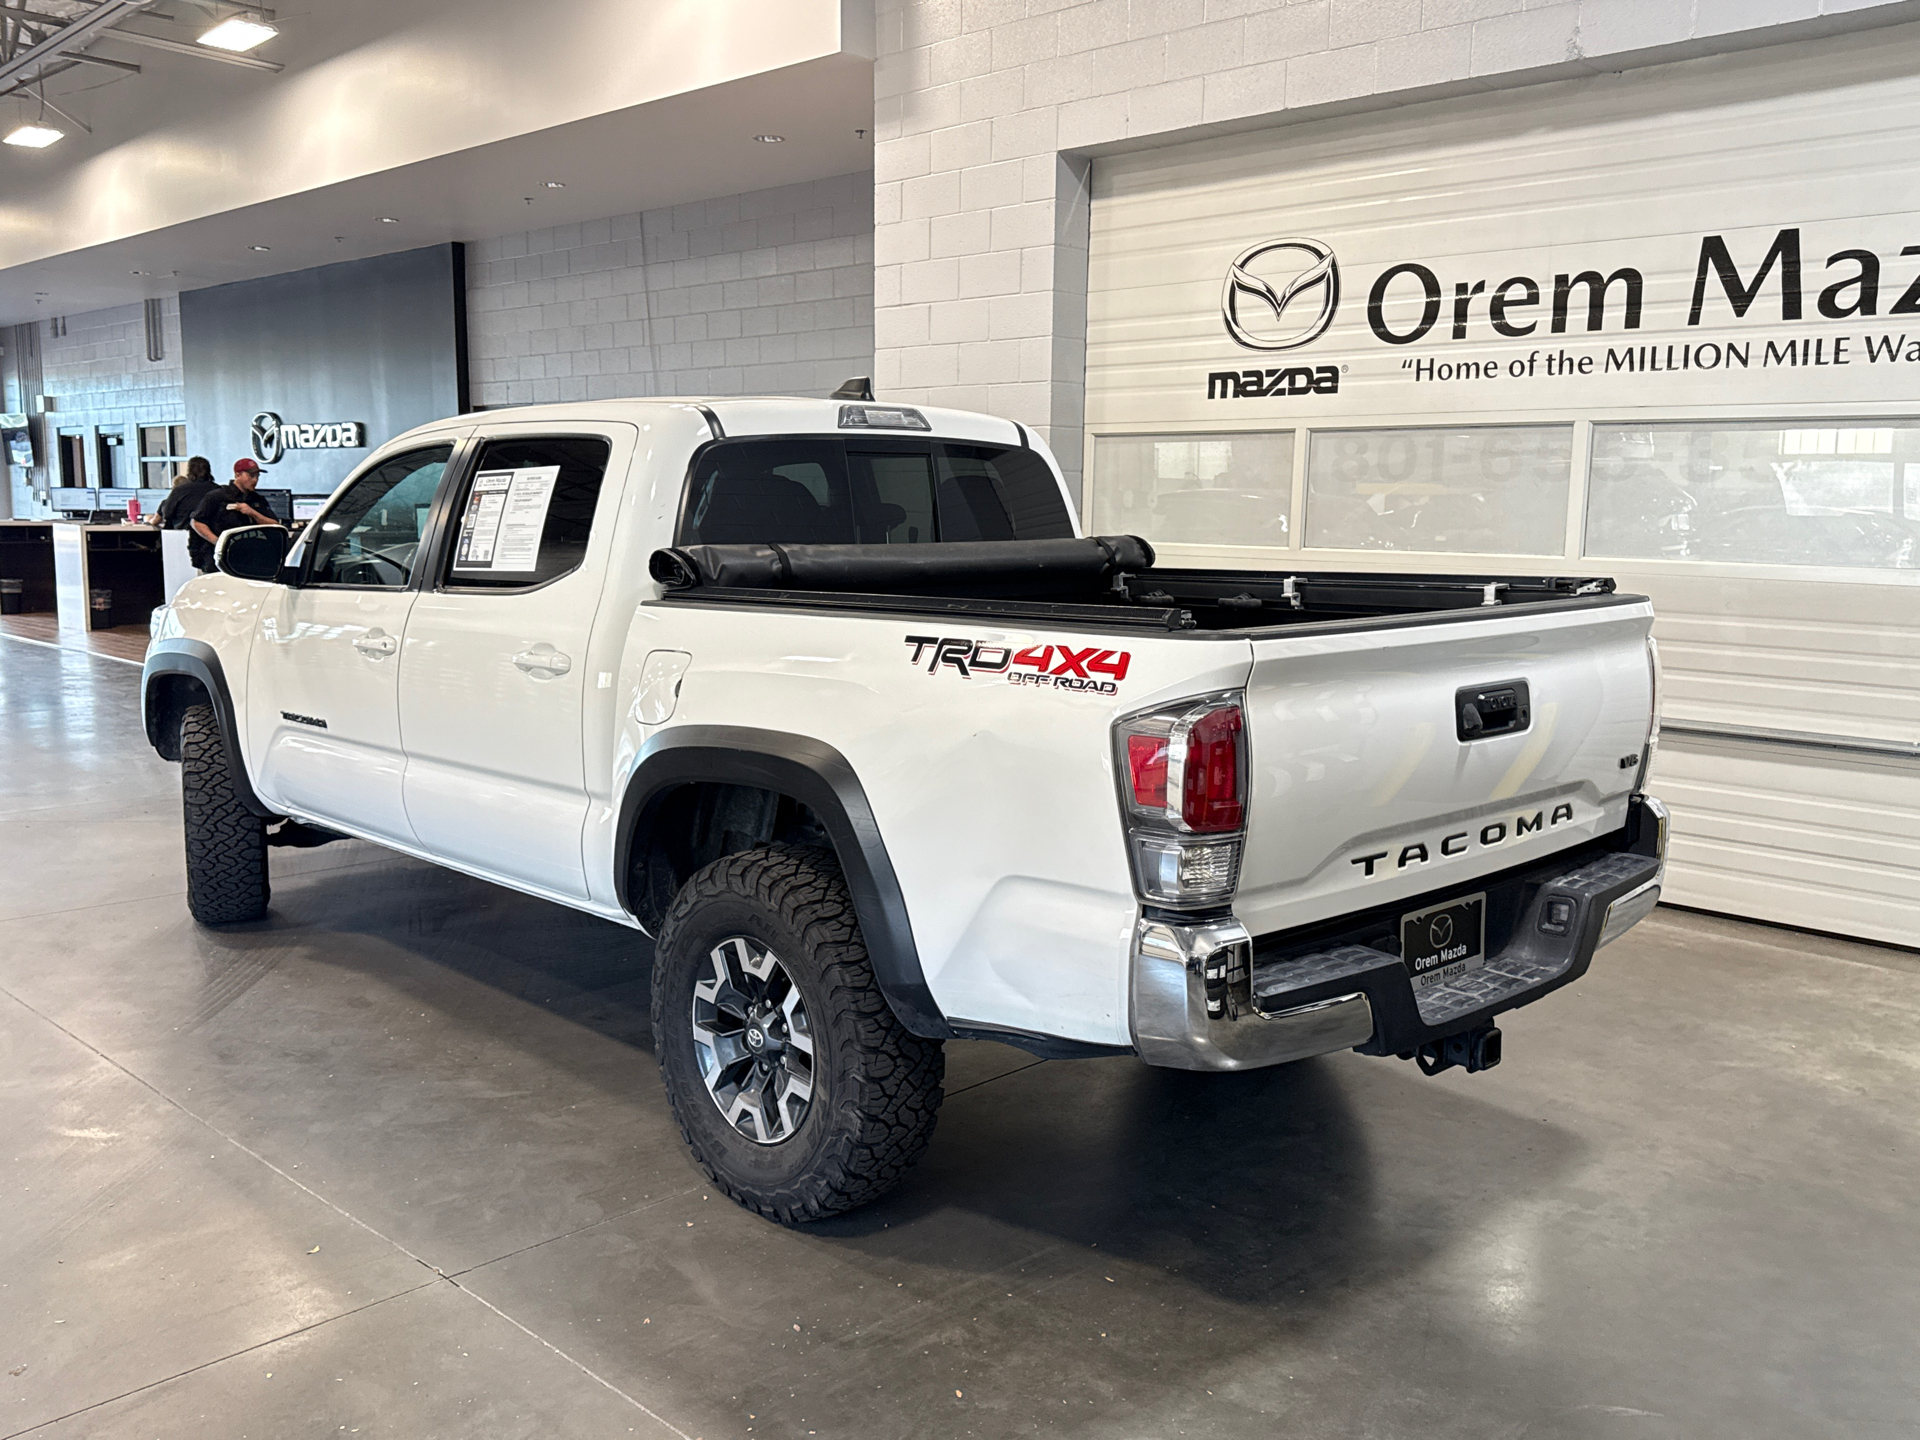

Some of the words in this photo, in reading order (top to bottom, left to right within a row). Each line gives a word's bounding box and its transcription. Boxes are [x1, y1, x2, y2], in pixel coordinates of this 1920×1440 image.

[1367, 263, 1643, 345] Orem
[1508, 350, 1540, 377] of
[1546, 349, 1593, 376] the
[1604, 341, 1750, 374] MILLION
[1763, 337, 1850, 368] MILE
[1007, 671, 1050, 688] OFF
[1053, 676, 1119, 696] ROAD
[1351, 802, 1574, 877] TACOMA
[1415, 954, 1439, 971] Orem
[1440, 943, 1467, 963] Mazda
[1420, 972, 1441, 987] Orem
[1442, 962, 1466, 979] Mazda
